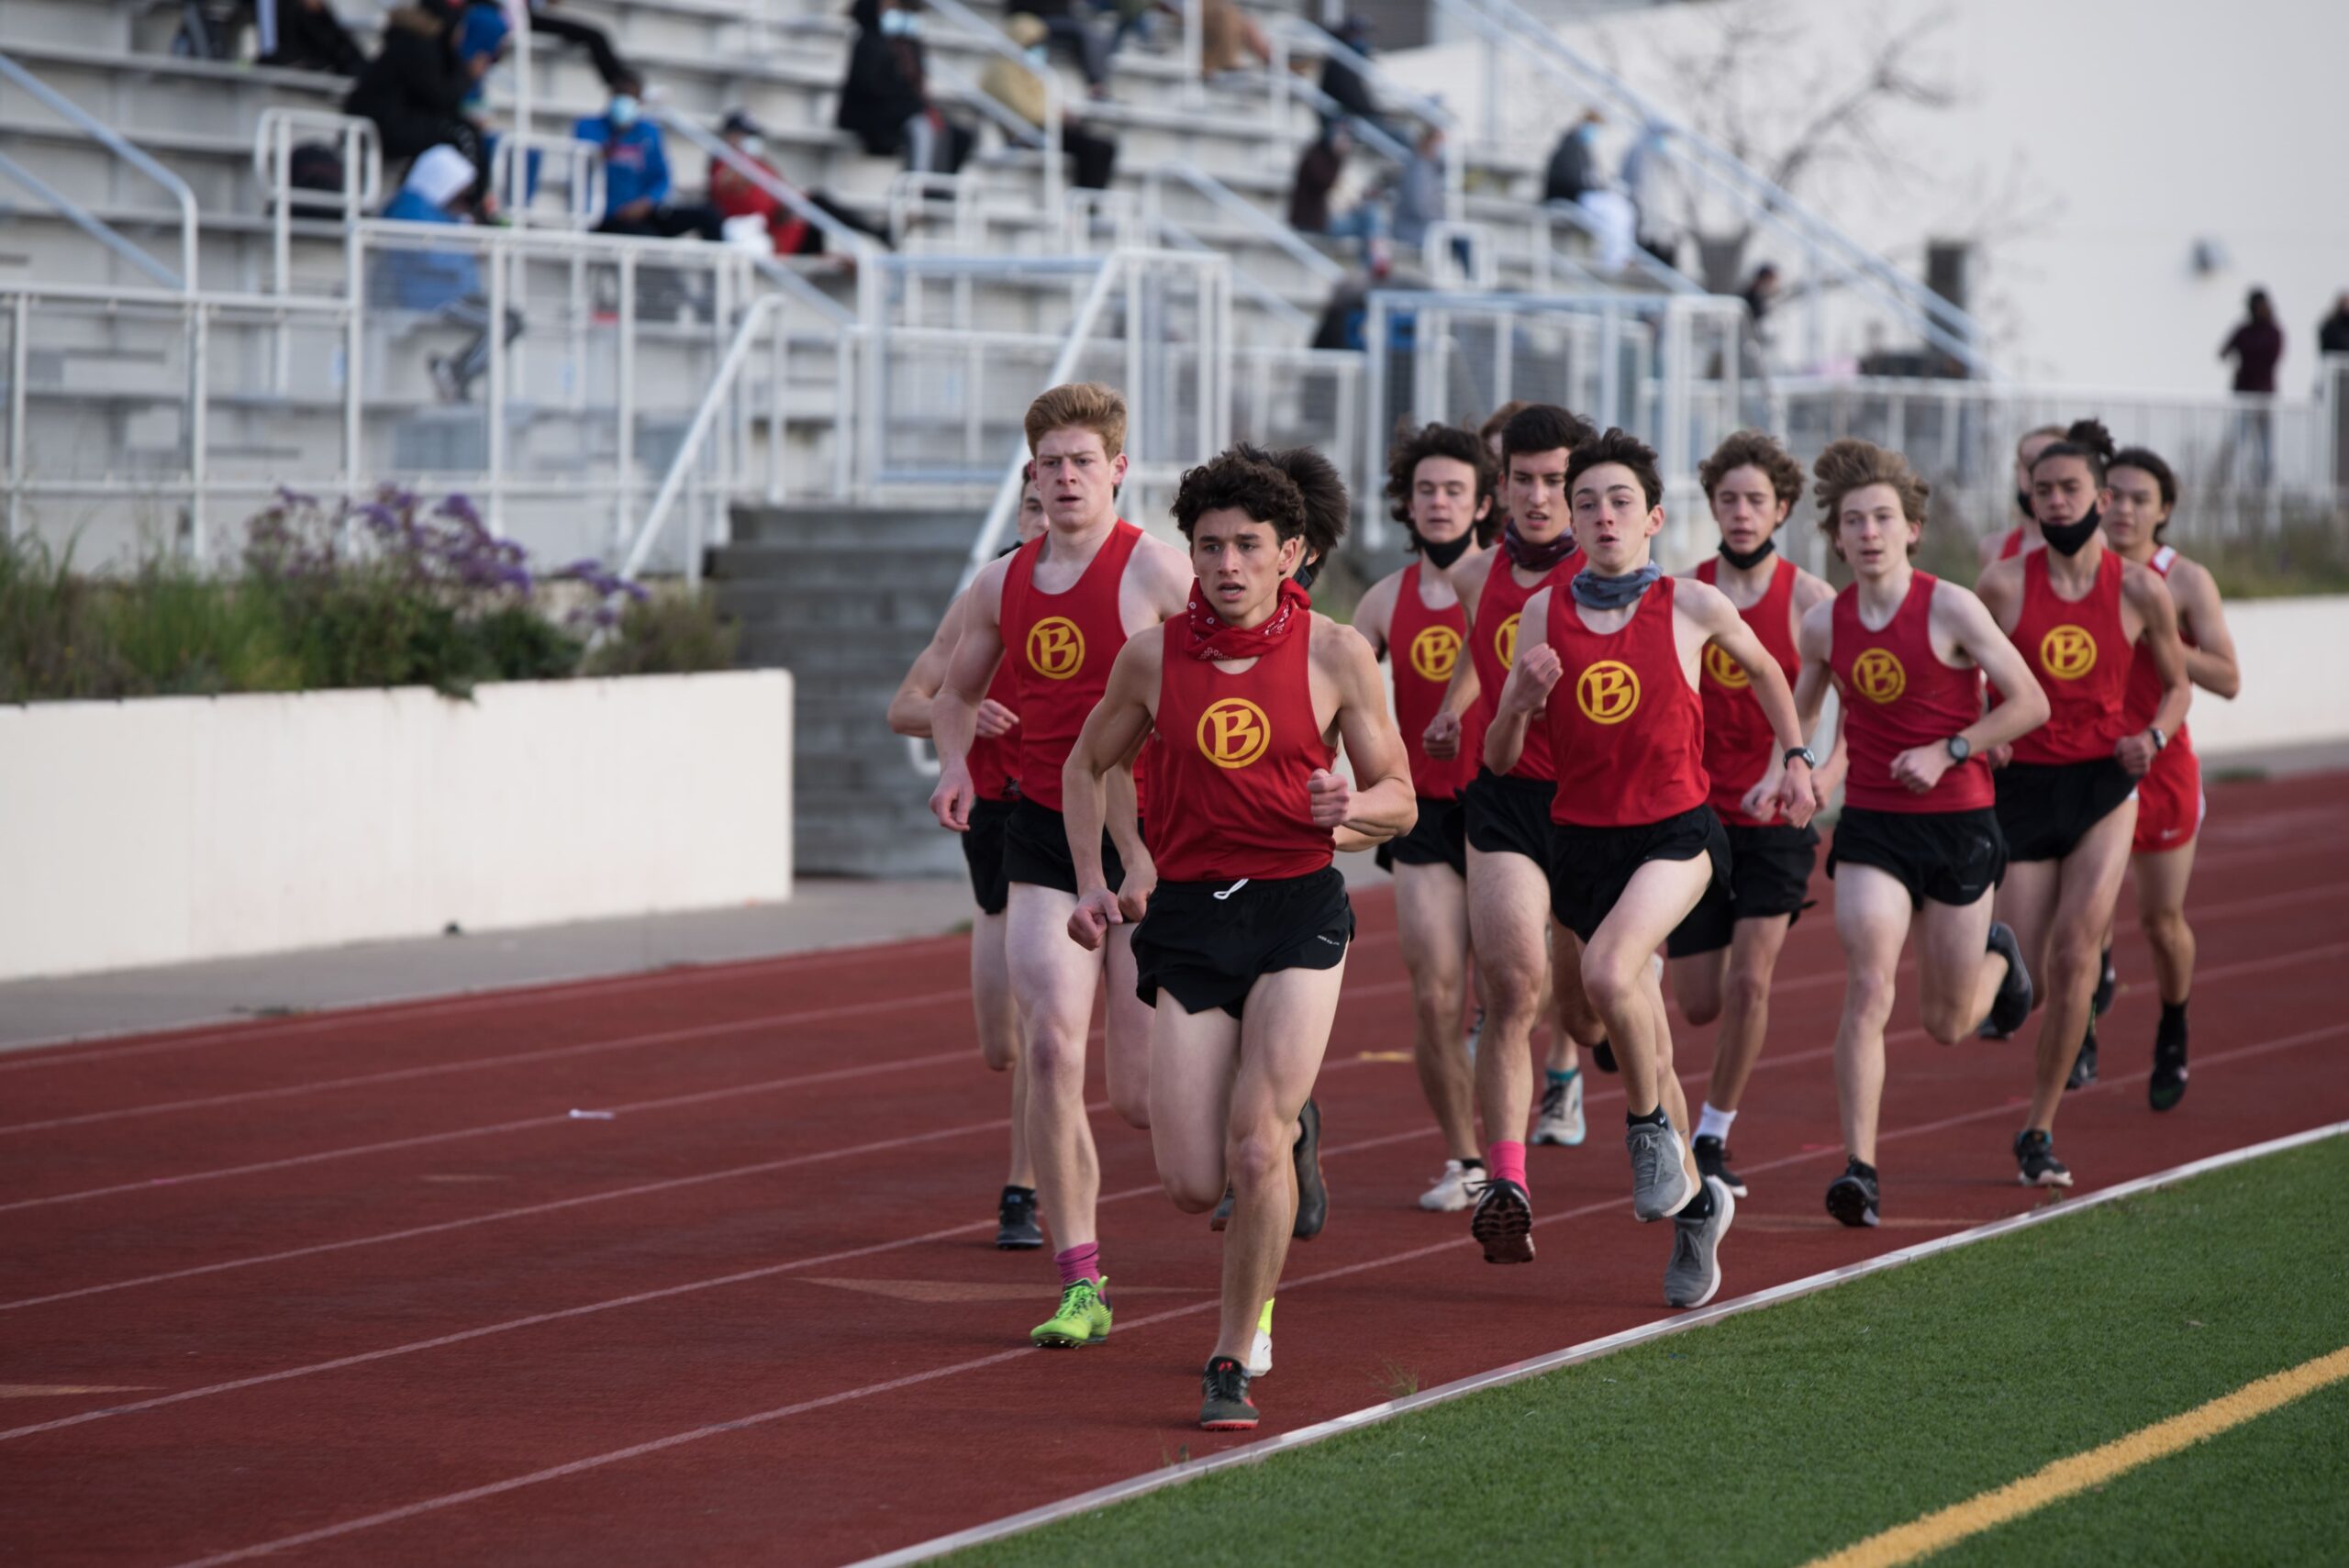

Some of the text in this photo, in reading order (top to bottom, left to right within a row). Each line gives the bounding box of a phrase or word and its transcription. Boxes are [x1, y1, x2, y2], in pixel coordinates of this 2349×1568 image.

[1033, 624, 1077, 673] B
[1419, 632, 1458, 673] B
[2050, 630, 2090, 673] B
[1587, 667, 1633, 717] B
[1860, 656, 1899, 699] B
[1208, 707, 1261, 761] B
